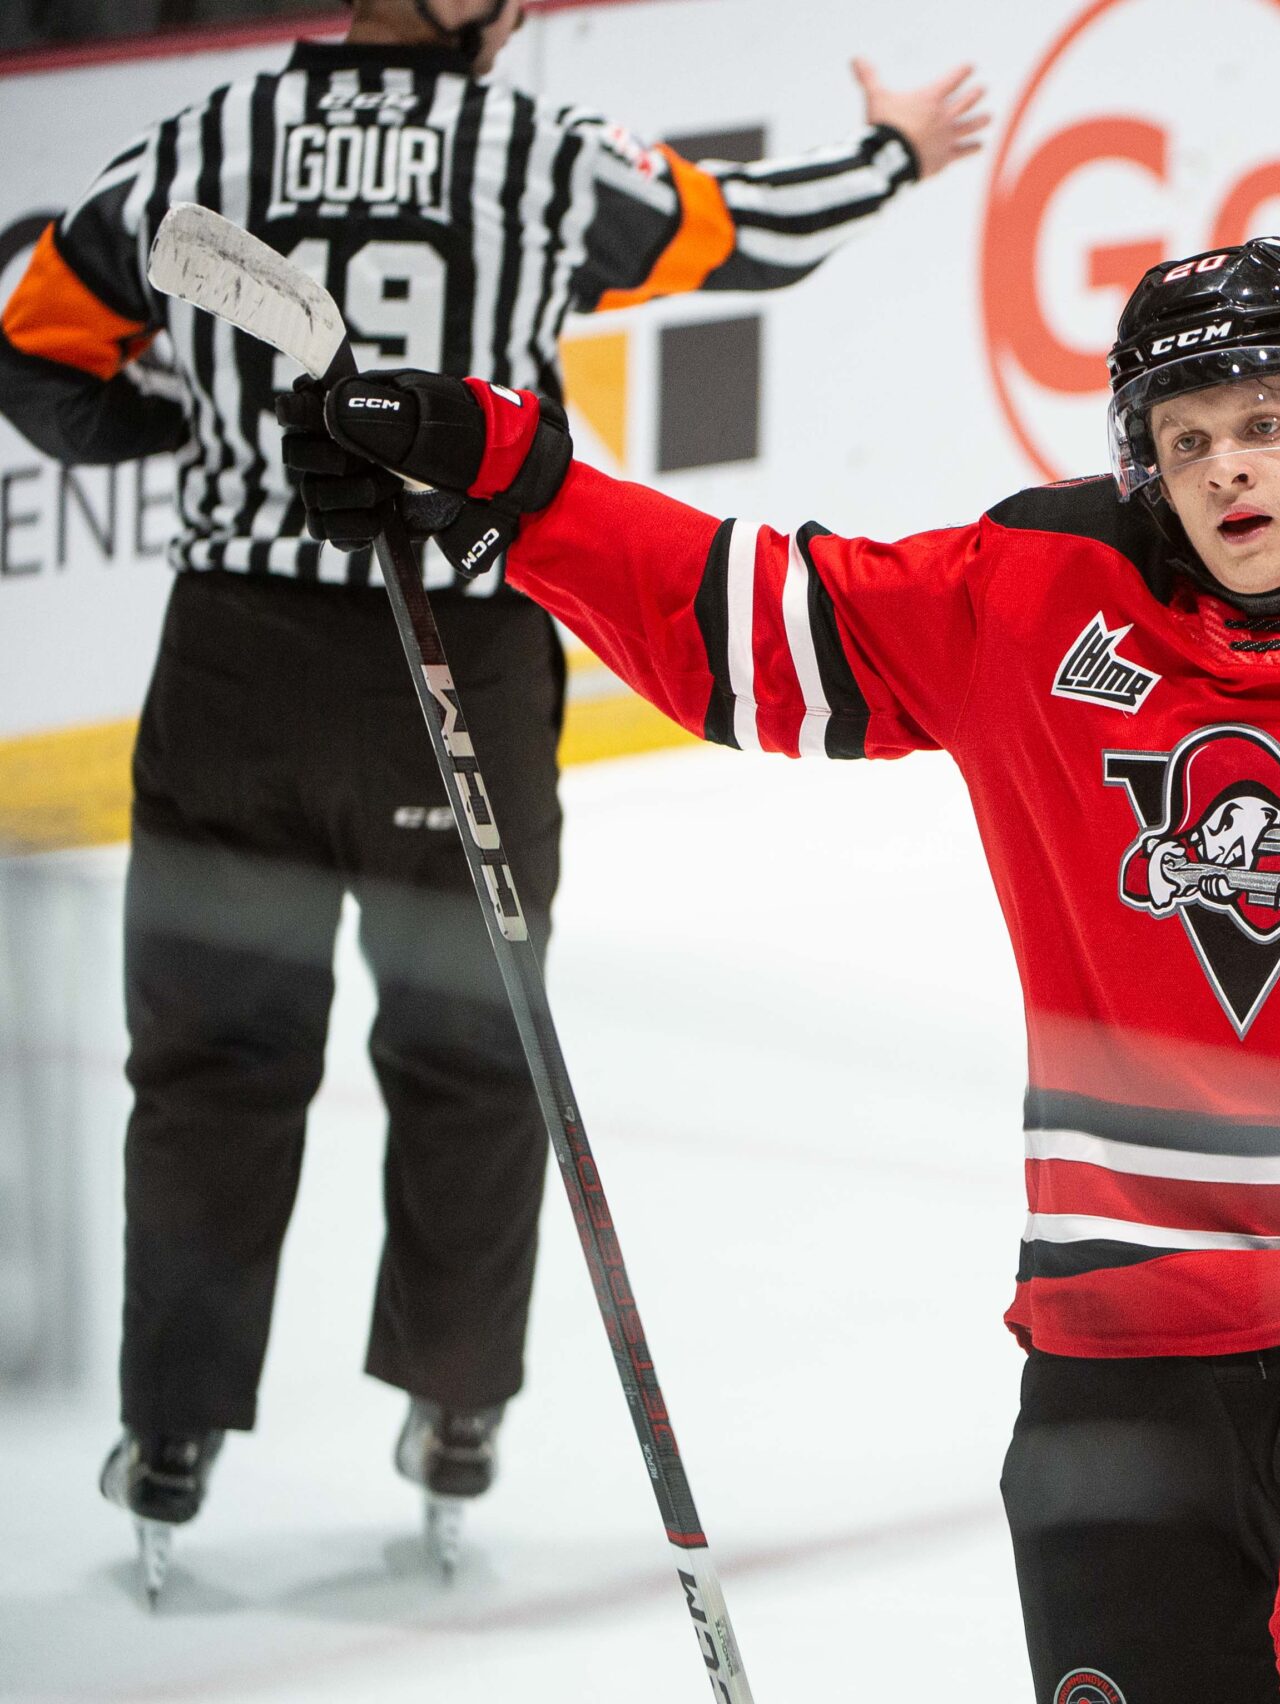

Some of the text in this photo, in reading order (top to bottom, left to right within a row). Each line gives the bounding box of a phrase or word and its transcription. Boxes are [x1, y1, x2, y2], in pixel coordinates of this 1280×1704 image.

[286, 124, 440, 206] GOUR
[1162, 254, 1230, 283] 20
[1150, 320, 1233, 356] CCM
[348, 397, 401, 411] CCM
[461, 527, 500, 570] CCM
[393, 805, 458, 831] CC
[420, 664, 528, 942] CCM
